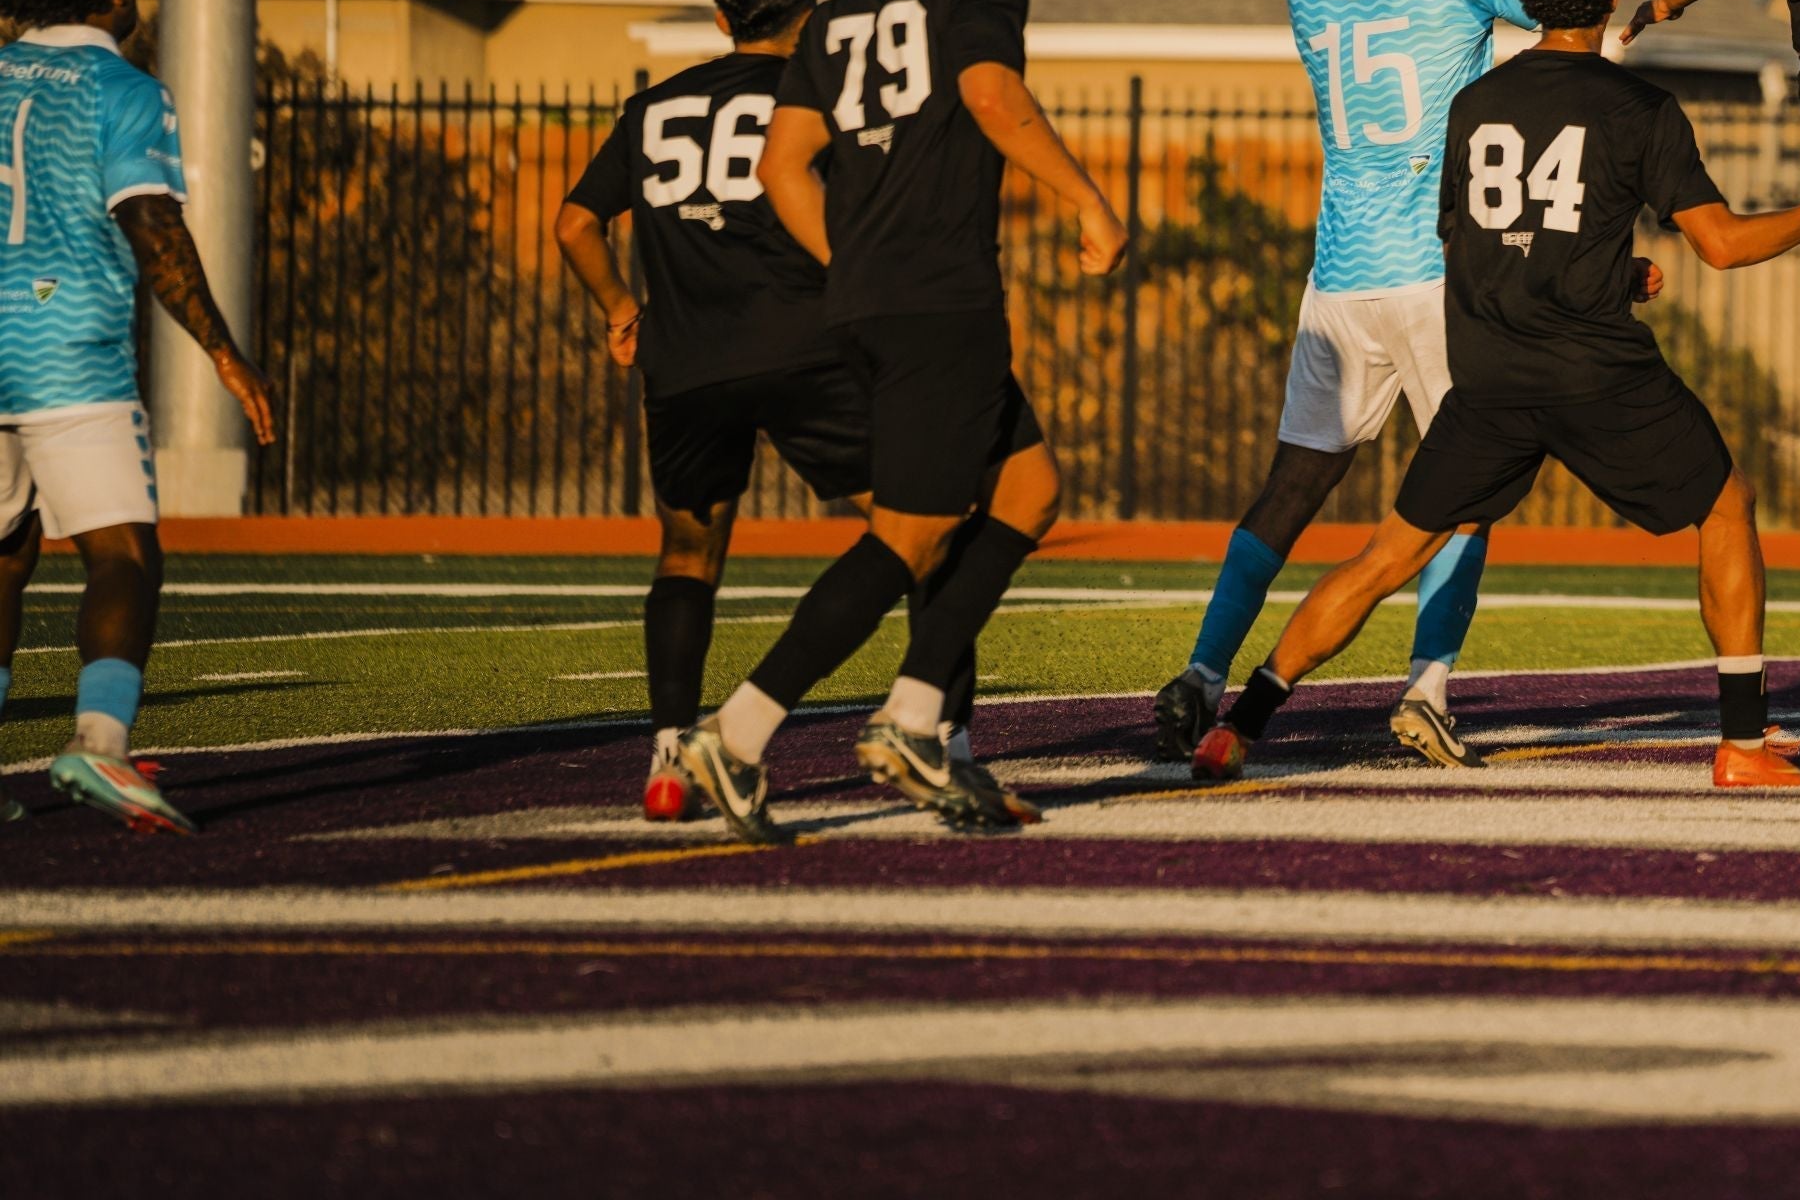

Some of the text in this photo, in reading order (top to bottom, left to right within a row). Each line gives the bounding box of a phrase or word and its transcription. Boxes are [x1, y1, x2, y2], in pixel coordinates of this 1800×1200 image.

[826, 0, 931, 132] 79
[1309, 16, 1423, 149] 15
[643, 94, 776, 208] 56
[1468, 123, 1587, 233] 84
